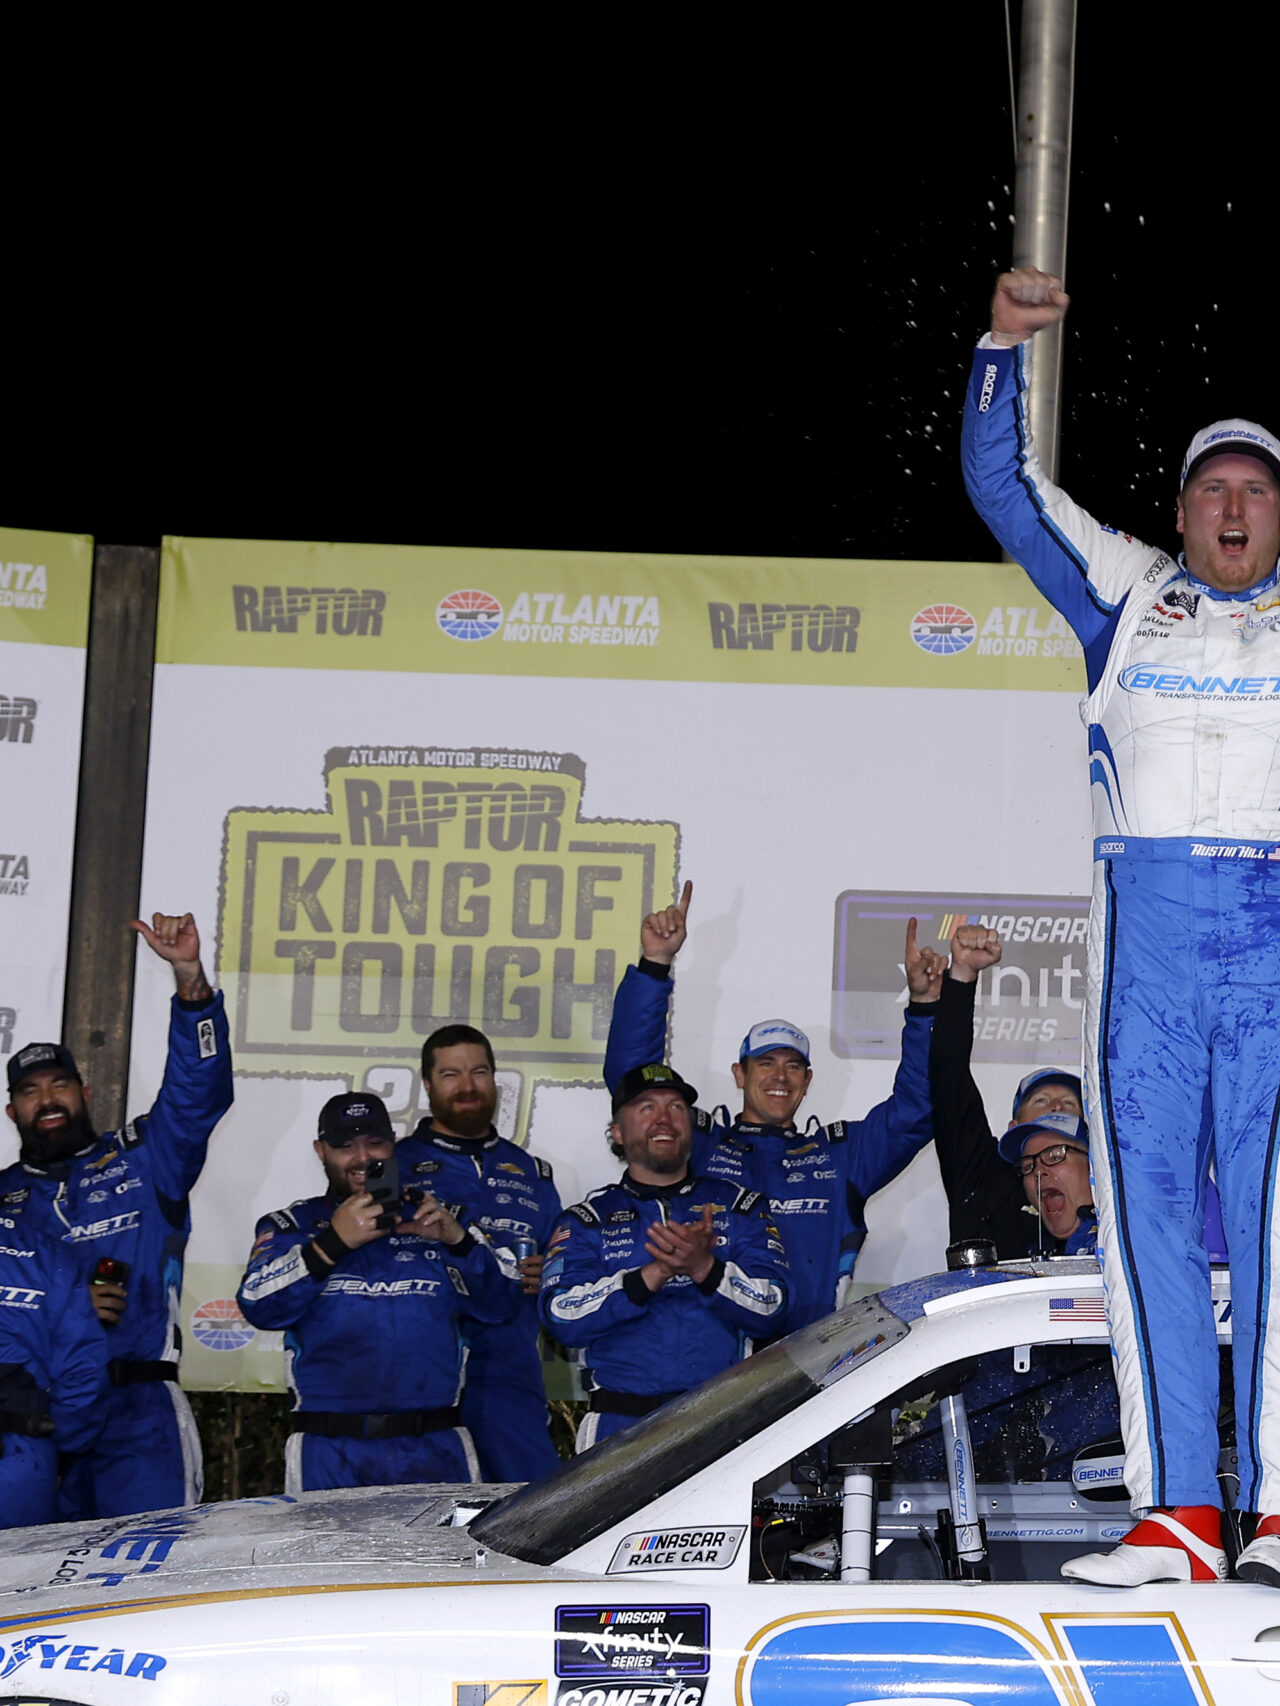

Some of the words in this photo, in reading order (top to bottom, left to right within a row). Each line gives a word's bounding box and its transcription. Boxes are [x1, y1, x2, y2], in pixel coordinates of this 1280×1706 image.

[232, 585, 386, 637] RAPTOR
[506, 593, 661, 627] ATLANTA
[708, 602, 860, 654] RAPTOR
[980, 606, 1077, 638] ATLA
[503, 622, 565, 643] MOTOR
[569, 625, 659, 646] SPEEDWAY
[977, 638, 1038, 657] MOTOR
[1042, 639, 1084, 659] SPEE
[1154, 691, 1250, 702] TRANSPORTATION
[348, 749, 418, 767] ATLANTA
[423, 750, 475, 768] MOTOR
[480, 751, 562, 772] SPEEDWAY
[344, 778, 566, 852] RAPTOR
[278, 856, 491, 937] KING
[512, 863, 622, 940] OF
[275, 939, 616, 1040] TOUGH
[769, 1198, 830, 1210] NETT
[70, 1211, 141, 1237] NETT
[480, 1216, 534, 1233] NETT
[322, 1279, 441, 1294] BENNETT
[956, 1447, 968, 1521] BENNETT
[1079, 1466, 1125, 1480] BENNET
[654, 1532, 726, 1550] NASCAR
[628, 1551, 676, 1566] RACE
[681, 1550, 718, 1563] CAR
[616, 1611, 667, 1625] NASCAR
[611, 1655, 653, 1668] SERIES
